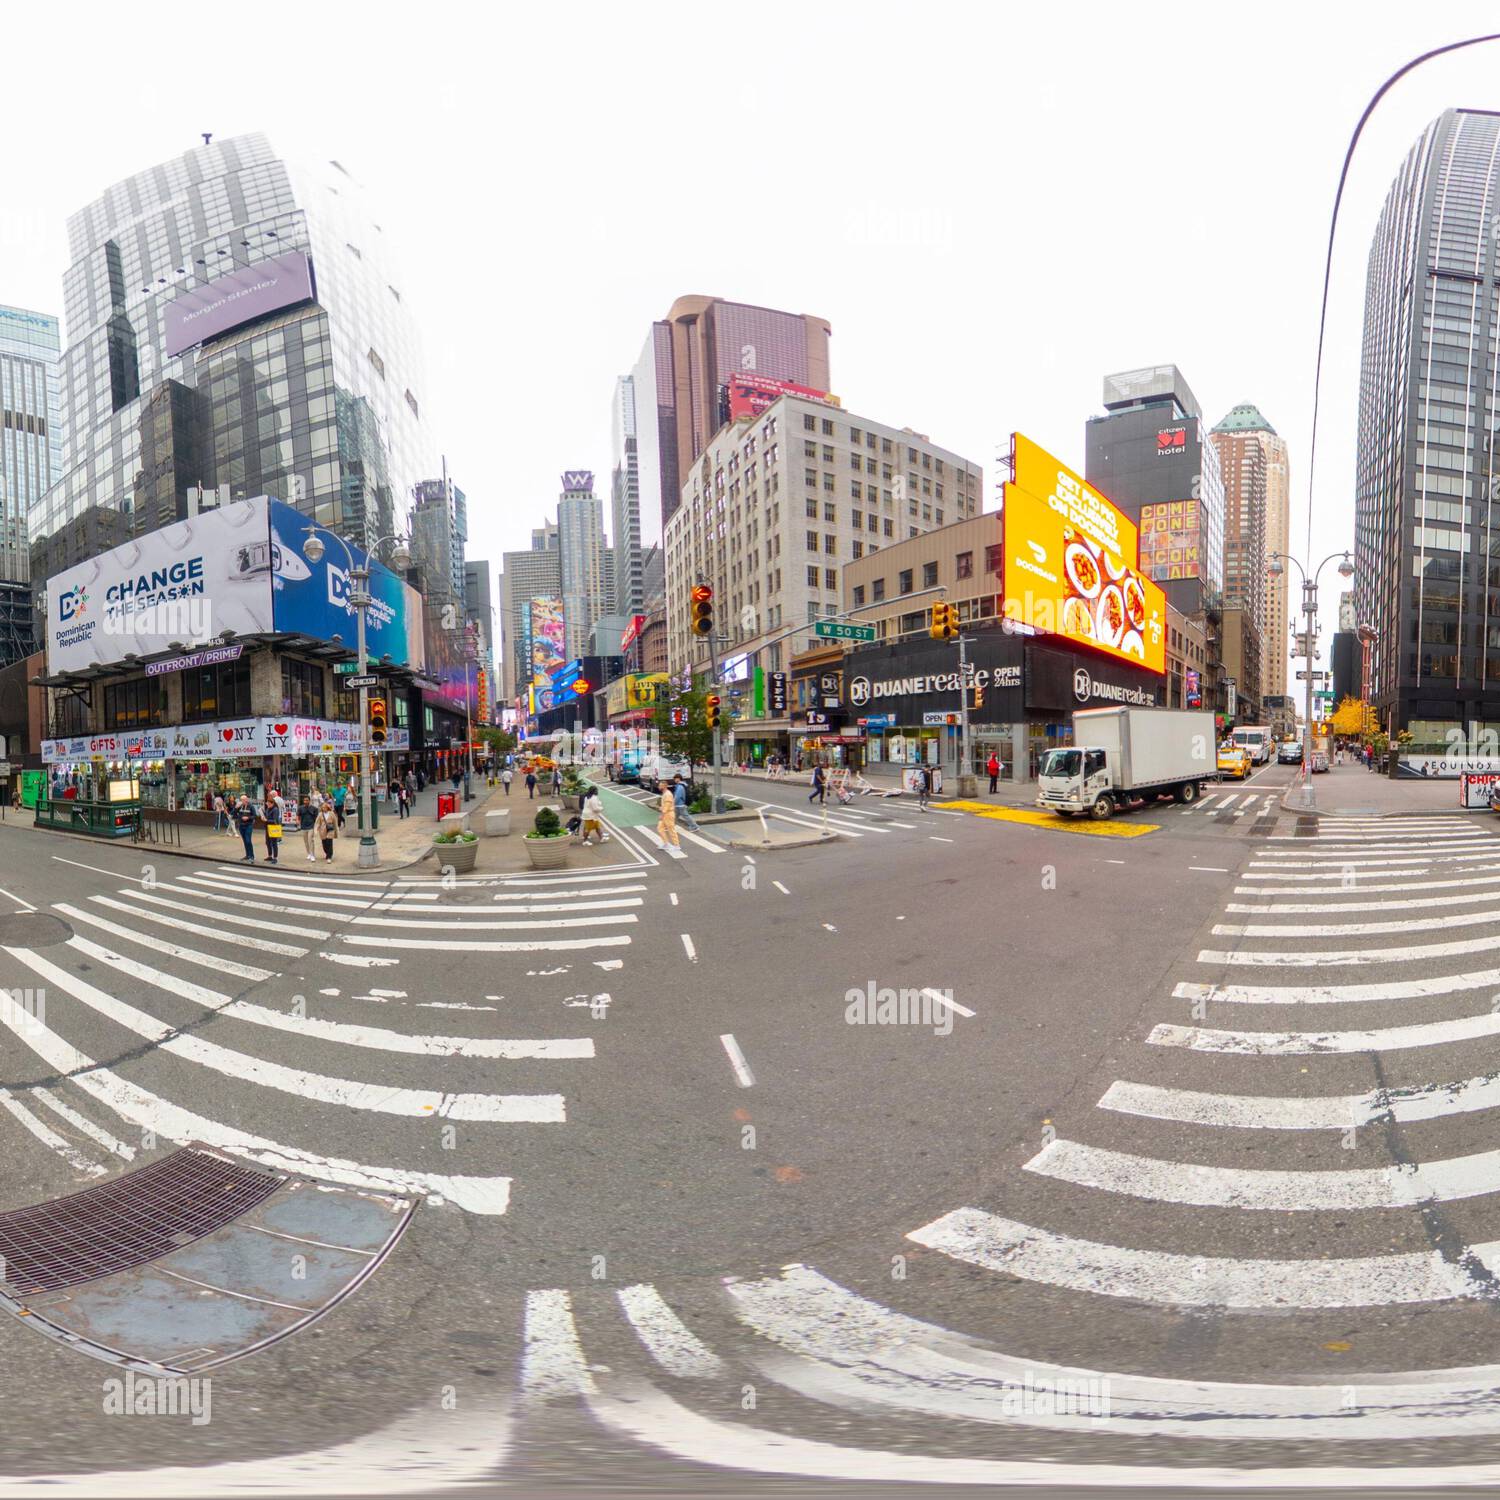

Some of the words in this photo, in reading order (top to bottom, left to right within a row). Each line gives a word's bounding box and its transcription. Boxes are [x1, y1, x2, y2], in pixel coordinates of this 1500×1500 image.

[183, 298, 225, 322] Morgan
[226, 279, 278, 302] Stanley
[1158, 426, 1186, 434] citizen
[1157, 446, 1186, 456] hotel
[568, 473, 589, 486] W
[106, 556, 204, 603] CHANGE
[106, 601, 133, 621] THE
[56, 620, 96, 640] Dominican
[822, 624, 832, 634] W
[836, 625, 852, 637] 50
[856, 628, 868, 639] ST
[59, 631, 92, 648] Republic
[147, 656, 200, 675] OUTFRONT
[206, 648, 239, 662] PRIME
[994, 667, 1021, 678] OPEN
[994, 677, 1021, 687] 24hrs
[773, 673, 784, 709] GIFTS
[924, 715, 943, 723] OPEN
[234, 727, 256, 740] NY
[295, 724, 322, 741] GIFTS
[975, 725, 1012, 736] pharmacy
[90, 738, 115, 752] GIFTS
[266, 736, 289, 748] NY
[1431, 761, 1493, 771] EQUINOX
